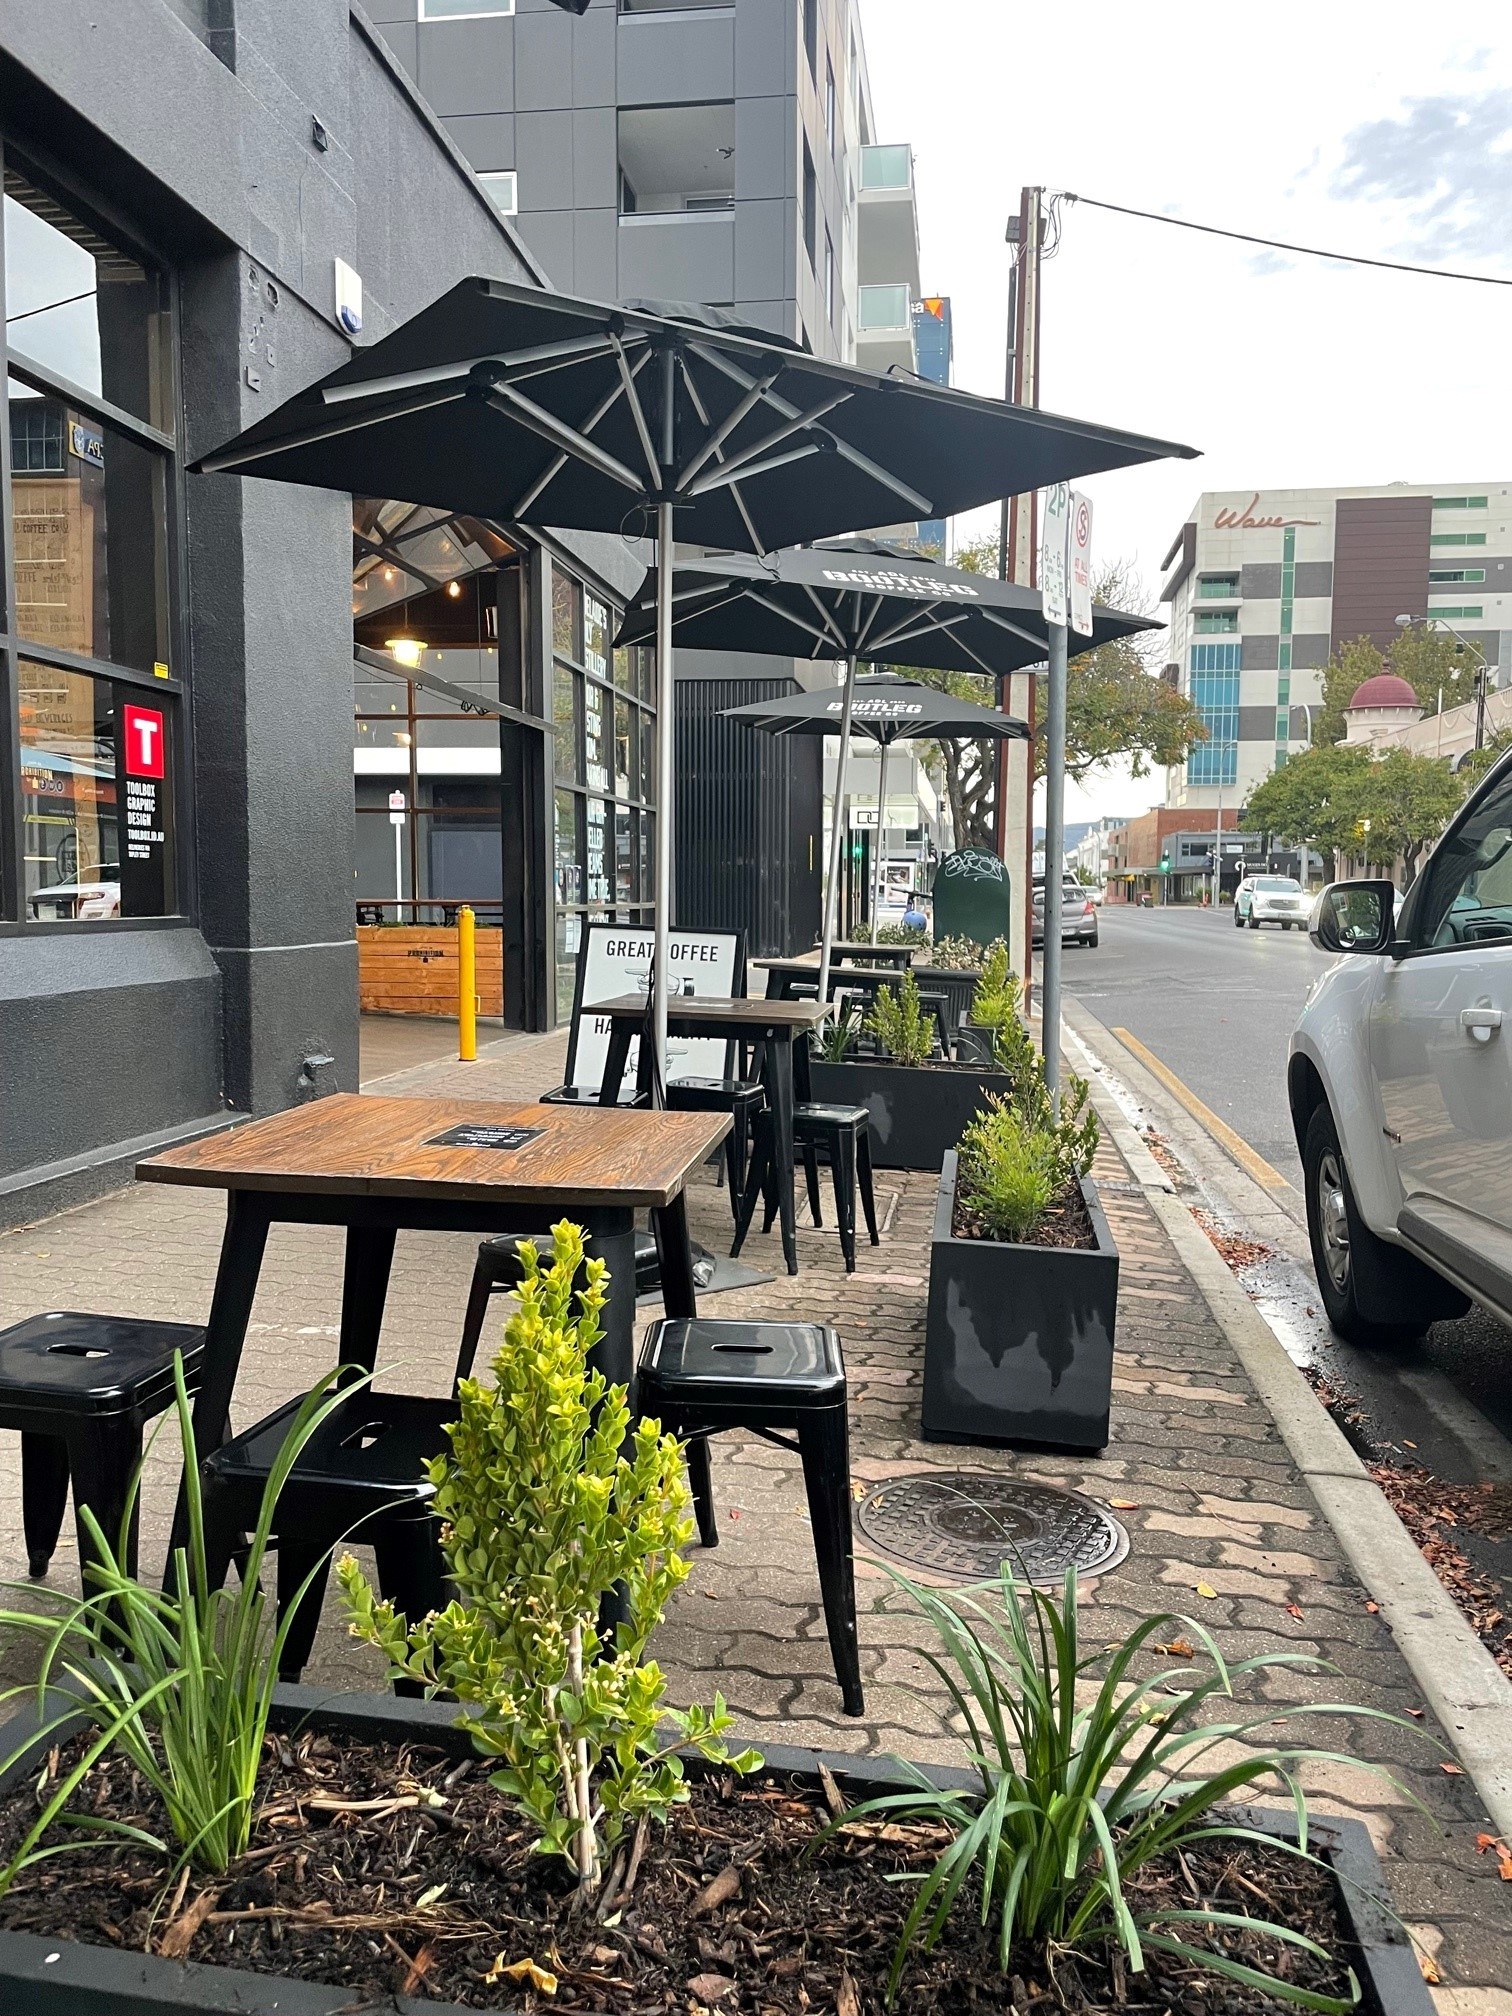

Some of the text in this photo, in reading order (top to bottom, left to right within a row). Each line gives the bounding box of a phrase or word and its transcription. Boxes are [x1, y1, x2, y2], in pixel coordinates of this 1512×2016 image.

[1048, 482, 1066, 517] 2P
[1214, 492, 1321, 529] Wave
[822, 570, 980, 597] BOOTLEG
[865, 583, 927, 594] COFFEE
[126, 781, 156, 798] TOOLBOX
[127, 797, 156, 812] GRAPHIC
[127, 812, 152, 827] DESIGN
[606, 940, 719, 963] GREAT OFFEE
